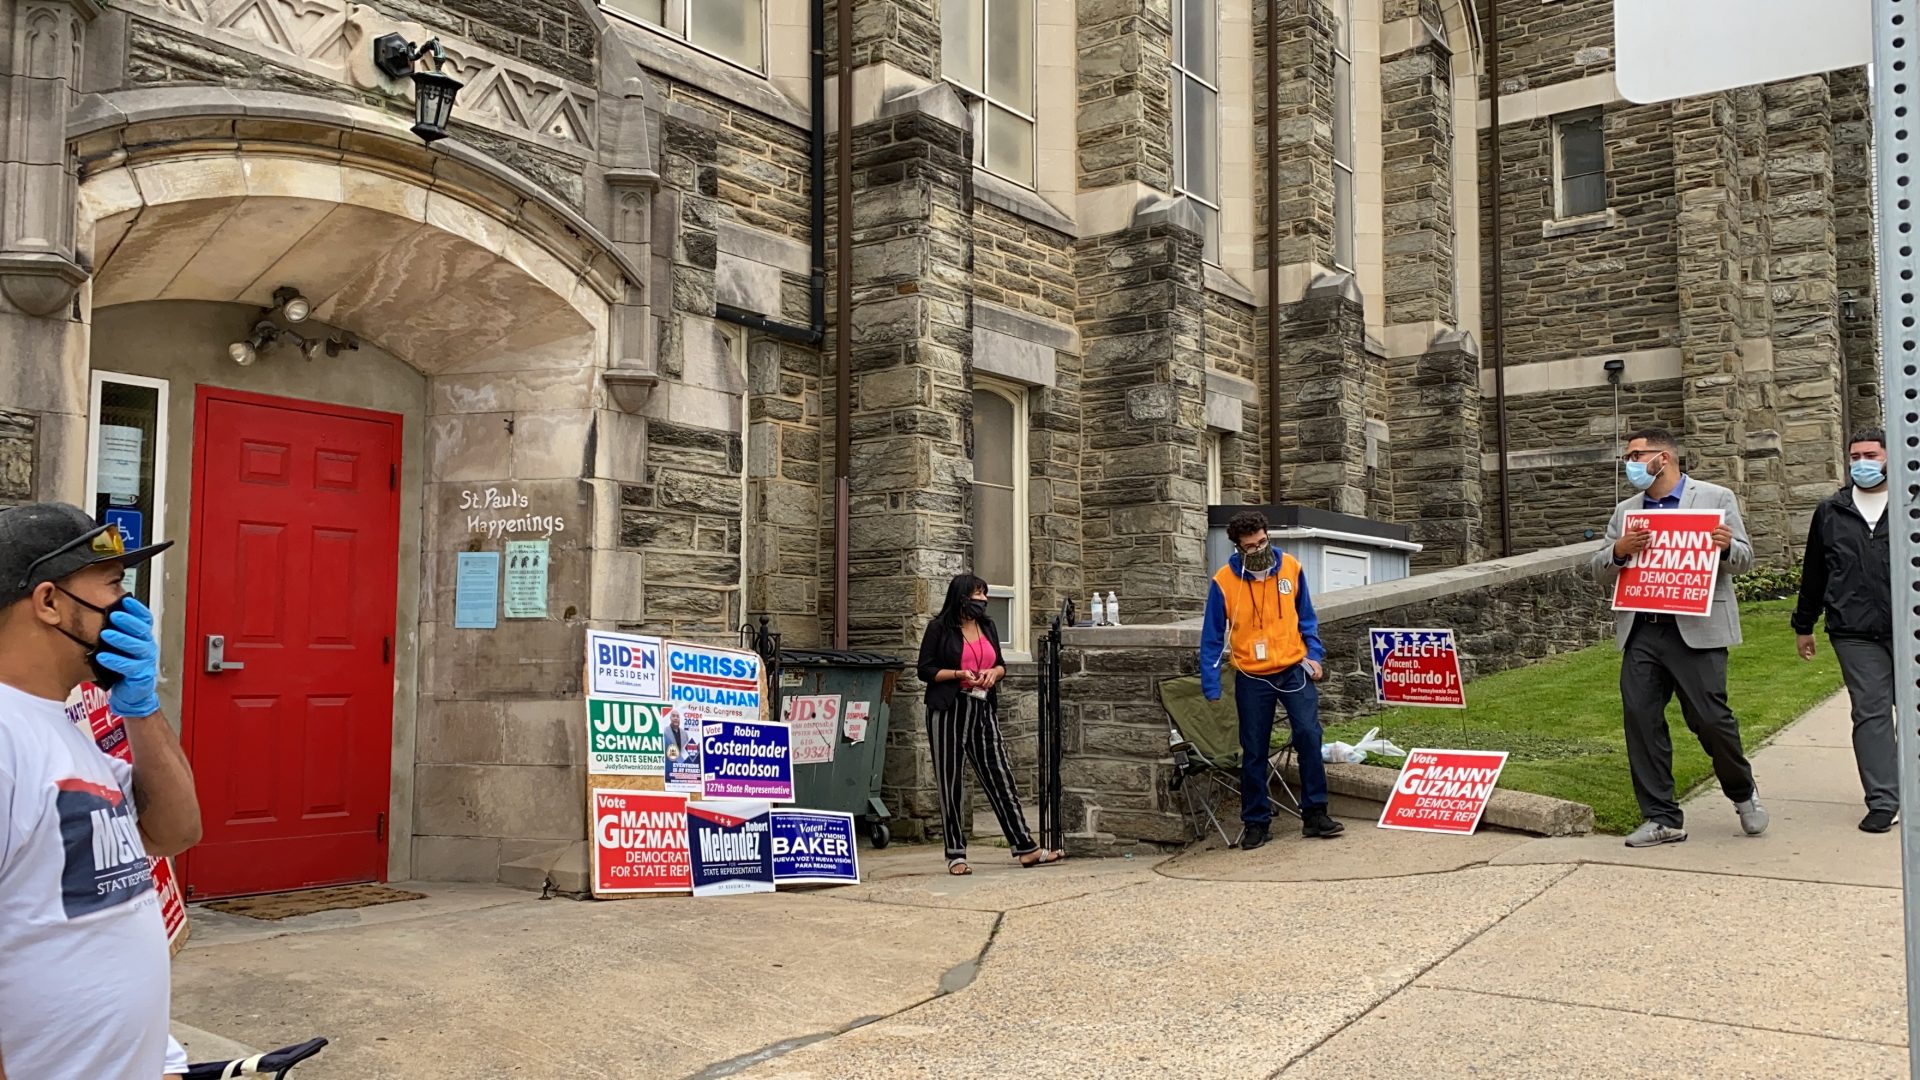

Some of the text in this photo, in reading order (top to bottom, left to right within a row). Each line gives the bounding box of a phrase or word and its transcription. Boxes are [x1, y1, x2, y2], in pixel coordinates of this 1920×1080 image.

[467, 514, 564, 540] Happenings
[1626, 516, 1650, 528] Vote
[1640, 571, 1712, 586] DEMOCRAT
[1624, 586, 1708, 600] FOR STATE REP
[1394, 636, 1446, 658] ELECT!
[598, 643, 656, 669] BIDEN
[670, 651, 758, 679] CHRISSY
[1388, 659, 1421, 668] Vincent D.
[599, 667, 656, 681] PRESIDENT
[1384, 669, 1456, 688] Gagliardo Jr
[671, 685, 758, 707] HOULAHAN
[714, 707, 742, 716] Congress
[734, 726, 760, 738] Robin
[596, 734, 662, 751] SCHWAN
[705, 737, 787, 759] Costenbader
[596, 754, 613, 762] OUR
[638, 755, 664, 763] SENAT
[792, 747, 830, 760] 6-9324
[1412, 754, 1438, 764] Vote
[714, 758, 780, 778] -Jacobson
[1424, 766, 1498, 782] MANNY
[706, 783, 790, 795] 127th State Representative
[1398, 768, 1491, 799] GUZMAN
[599, 796, 626, 808] Vote
[1415, 798, 1482, 811] DEMOCRAT
[621, 810, 687, 829] MANNY
[1396, 808, 1476, 822] FOR STATE REP
[598, 814, 688, 849] GUZMAN
[745, 822, 768, 832] Robert
[799, 822, 827, 834] Voten!
[699, 826, 761, 862] Melendez
[773, 837, 849, 856] BAKER
[626, 851, 689, 863] DEMOCRAT
[610, 865, 689, 877] FOR STATE REP
[720, 866, 762, 875] REPRESENTATIVE
